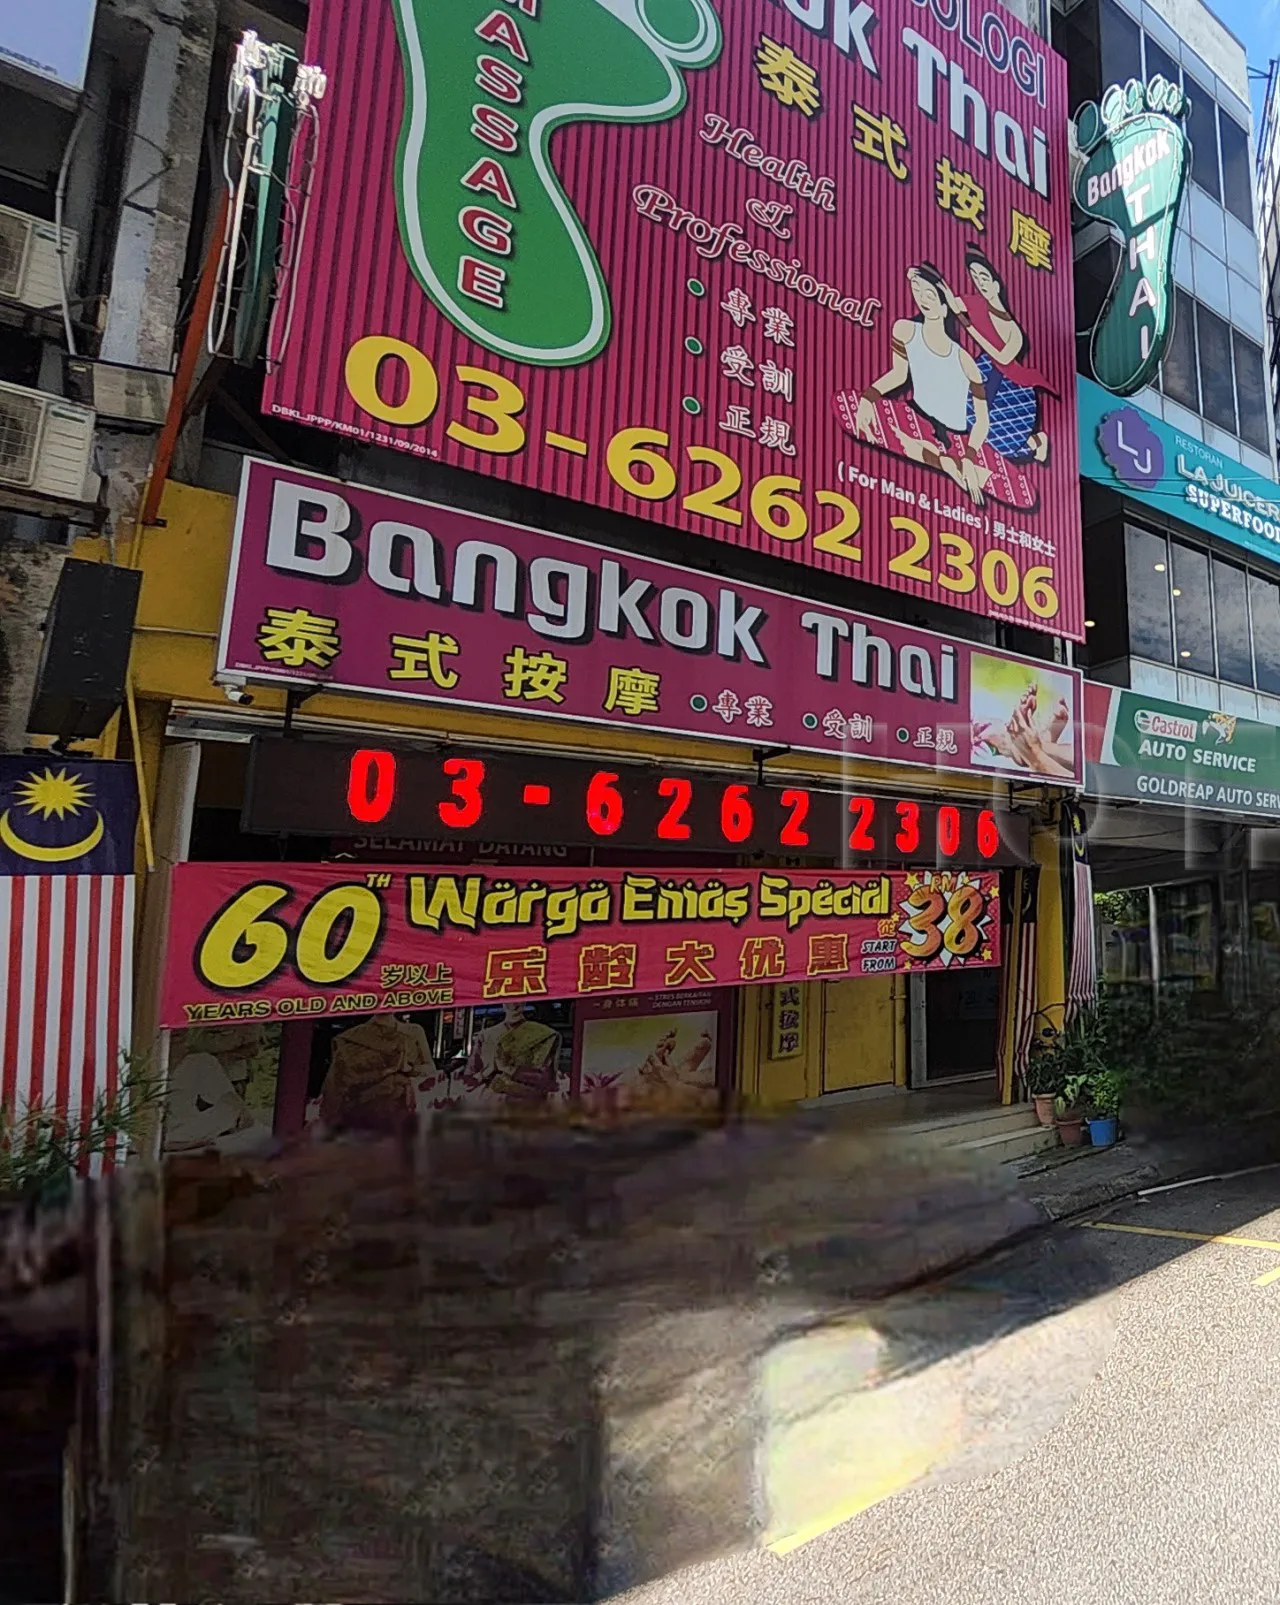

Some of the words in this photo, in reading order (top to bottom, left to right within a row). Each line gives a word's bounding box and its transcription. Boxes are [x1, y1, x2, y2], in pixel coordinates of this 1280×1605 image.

[902, 27, 1048, 198] Thai
[456, 0, 537, 309] ASSAGE
[700, 113, 836, 212] Health
[755, 34, 1052, 273] 泰式按摩
[1087, 129, 1171, 207] Bangkok
[746, 198, 793, 239] &
[632, 184, 882, 327] Professional
[1125, 184, 1157, 360] THAI
[720, 345, 794, 403] 受訓
[719, 404, 796, 456] 正規
[1175, 435, 1224, 469] RESTORAN
[881, 478, 915, 506] Man
[918, 492, 932, 512] &
[993, 519, 1057, 558] 男士和女士
[265, 478, 771, 665] Bangkok
[801, 610, 956, 701] Thai
[888, 516, 1060, 620] 2306
[259, 606, 663, 715] 泰式按摩
[821, 707, 874, 743] 受訓
[912, 726, 958, 754] 正規
[1151, 715, 1195, 740] Castrol
[1138, 739, 1187, 761] AUTO
[1192, 748, 1257, 773] SERVICE
[1136, 775, 1214, 801] GOLDREAP
[1216, 786, 1252, 806] AUTO
[929, 874, 957, 893] RM
[200, 884, 382, 989] 60
[365, 872, 392, 888] TH
[861, 938, 898, 954] START
[900, 885, 984, 957] 38
[380, 963, 453, 988] 岁以上
[483, 933, 850, 998] 乐龄大优惠
[861, 956, 897, 972] FROM
[185, 1001, 271, 1023] YEARS
[276, 996, 326, 1015] OLD
[331, 992, 378, 1011] AND
[382, 988, 454, 1007] ABOVE
